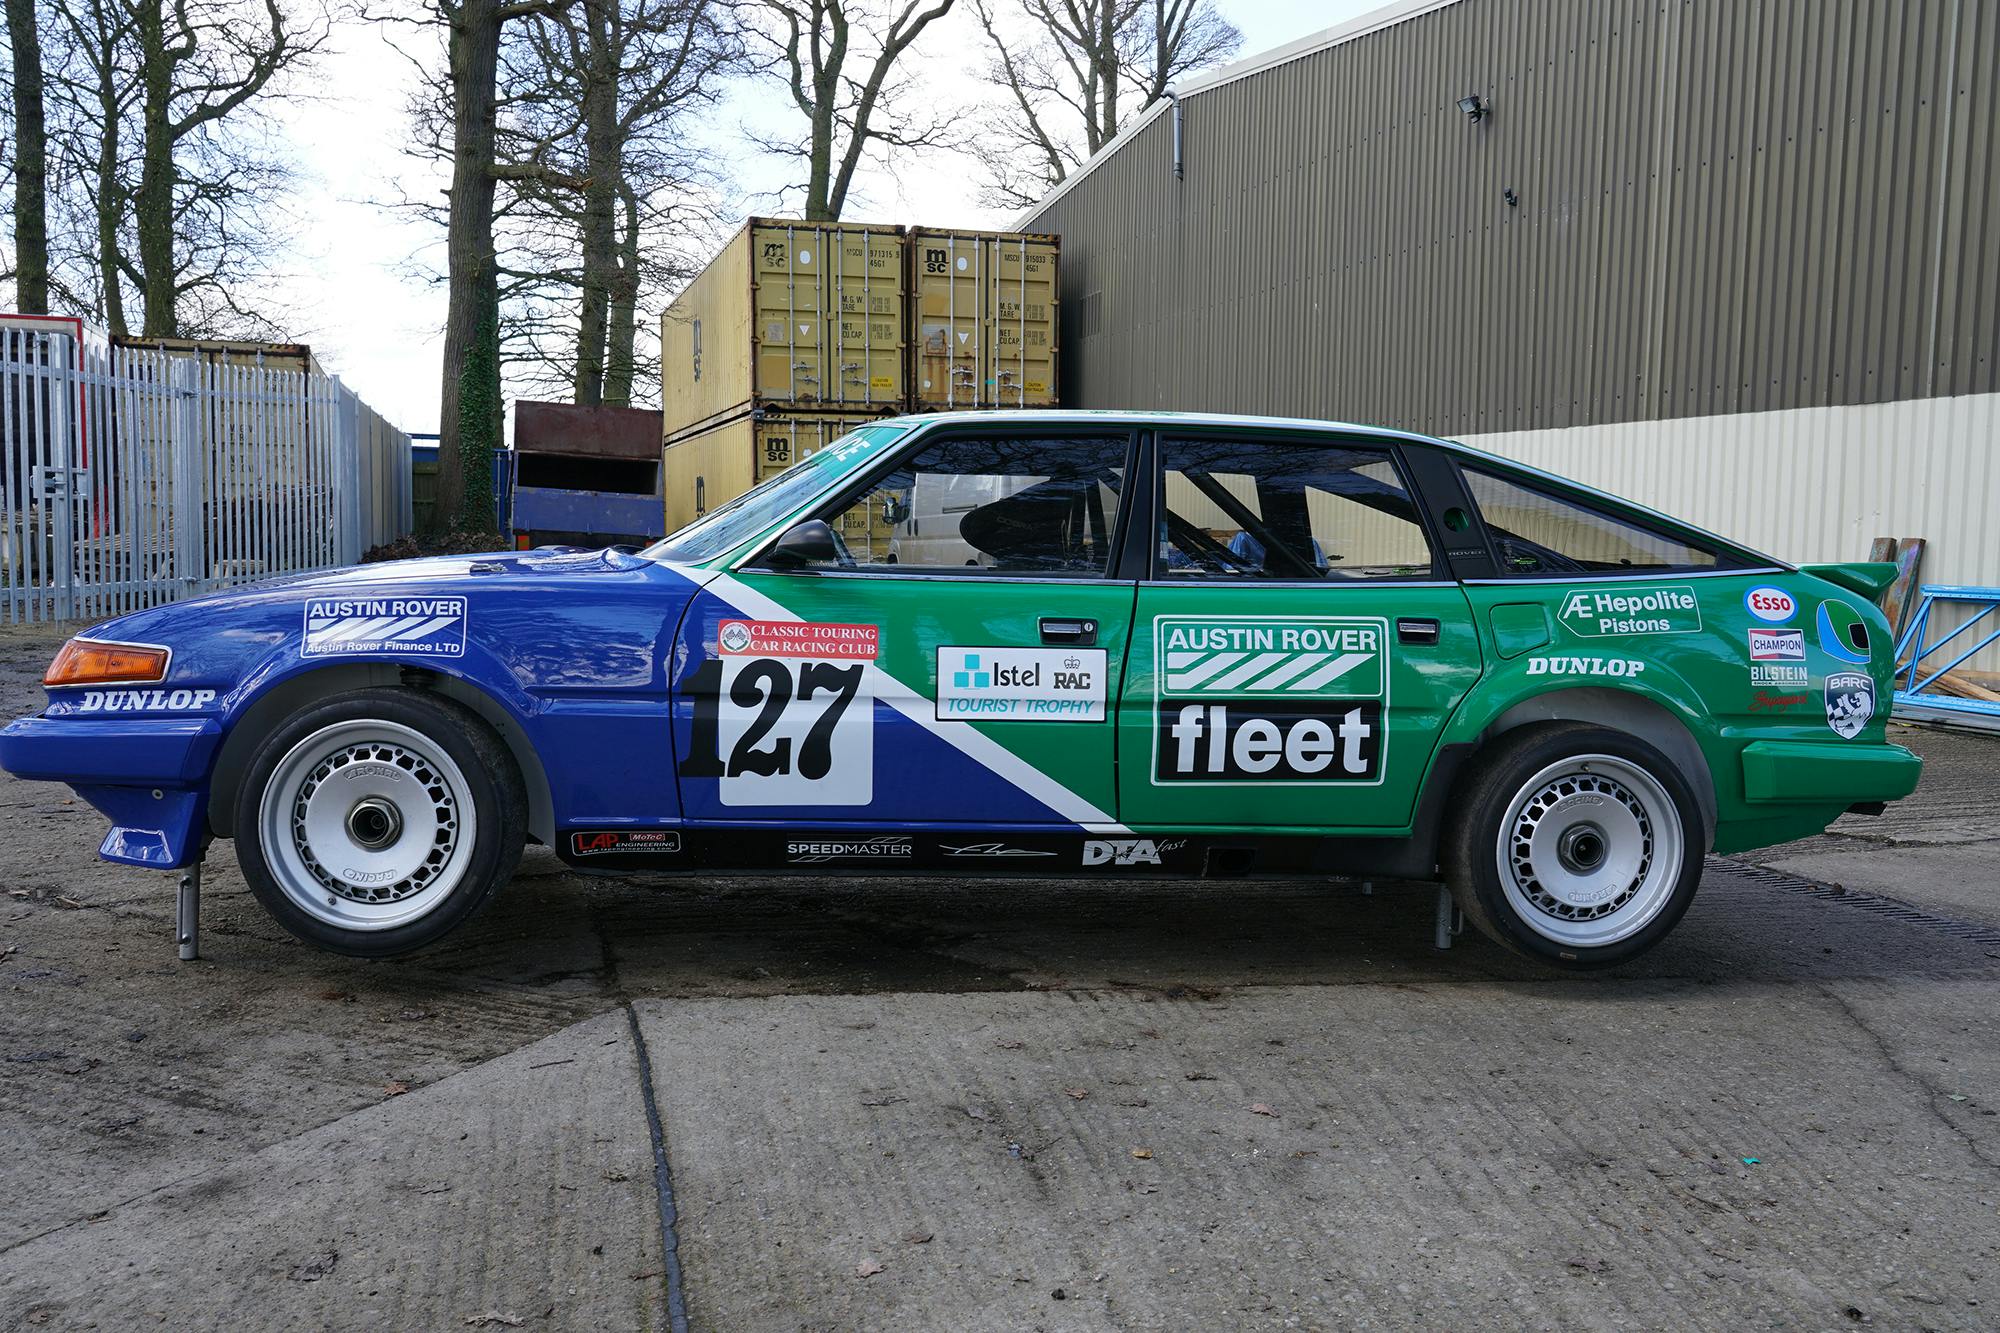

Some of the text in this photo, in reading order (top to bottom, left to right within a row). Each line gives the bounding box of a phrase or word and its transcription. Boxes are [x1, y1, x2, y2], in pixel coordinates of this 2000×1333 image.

[1004, 254, 1020, 262] MSCU
[309, 600, 462, 617] AUSTIN ROVER
[1594, 591, 1695, 616] Hepolite
[751, 625, 810, 638] CLASSIC
[812, 627, 876, 640] TOURING
[1599, 618, 1671, 633] Pistons
[305, 641, 460, 653] Austin Rover Finance LTD
[751, 640, 876, 655] CAR RACING CLUB
[1167, 628, 1377, 651] AUSTIN ROVER
[1753, 639, 1801, 650] CHAMPION
[1526, 657, 1645, 677] DUNLOP
[1751, 666, 1808, 681] BILSTEIN
[994, 662, 1091, 690] Istel RAC
[1830, 677, 1870, 691] BARC
[80, 689, 216, 711] DUNLOP
[948, 698, 1096, 714] TOURIST TROPHY
[679, 658, 864, 780] 127
[1172, 704, 1371, 773] fleet
[578, 833, 619, 850] LAP
[788, 843, 912, 854] SPEEDMASTER
